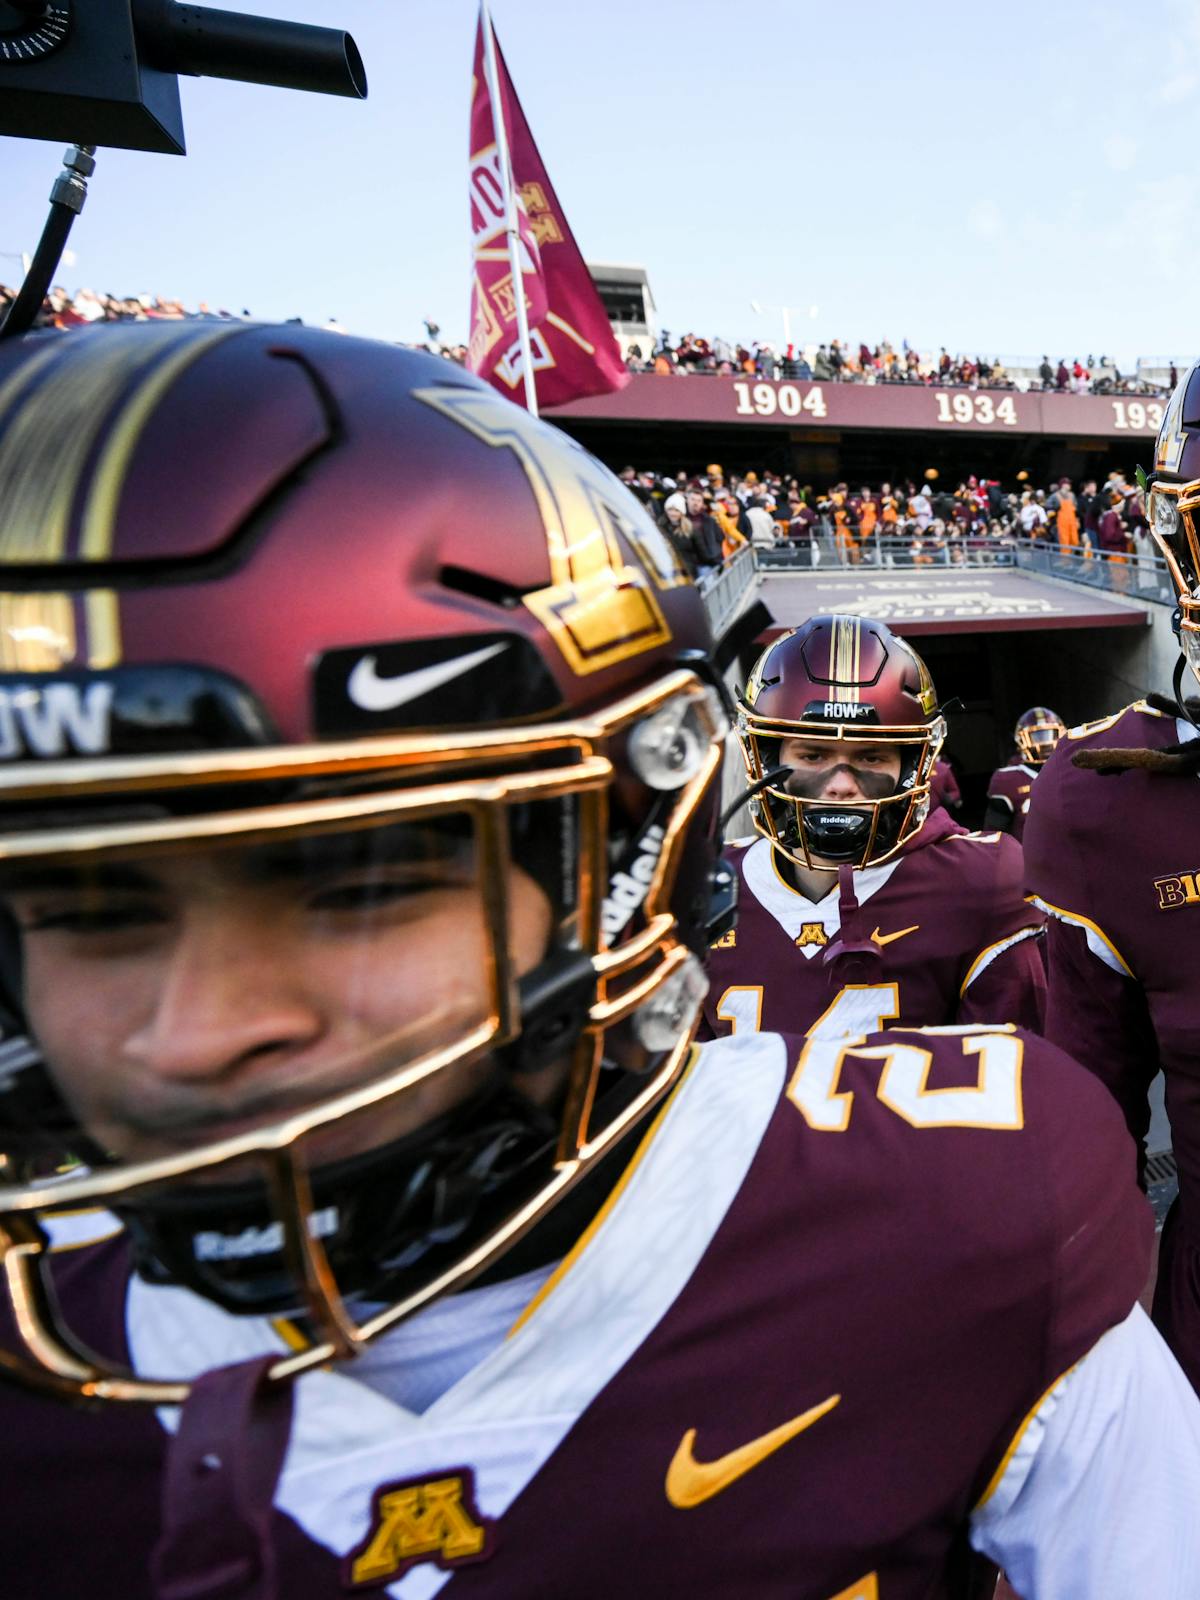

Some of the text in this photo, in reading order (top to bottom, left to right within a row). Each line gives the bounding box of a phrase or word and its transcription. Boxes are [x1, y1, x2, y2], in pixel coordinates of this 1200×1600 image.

[733, 383, 827, 417] 1904
[935, 392, 1017, 425] 1934
[824, 703, 858, 718] ROW
[820, 816, 852, 824] Riddell
[716, 982, 900, 1040] 14
